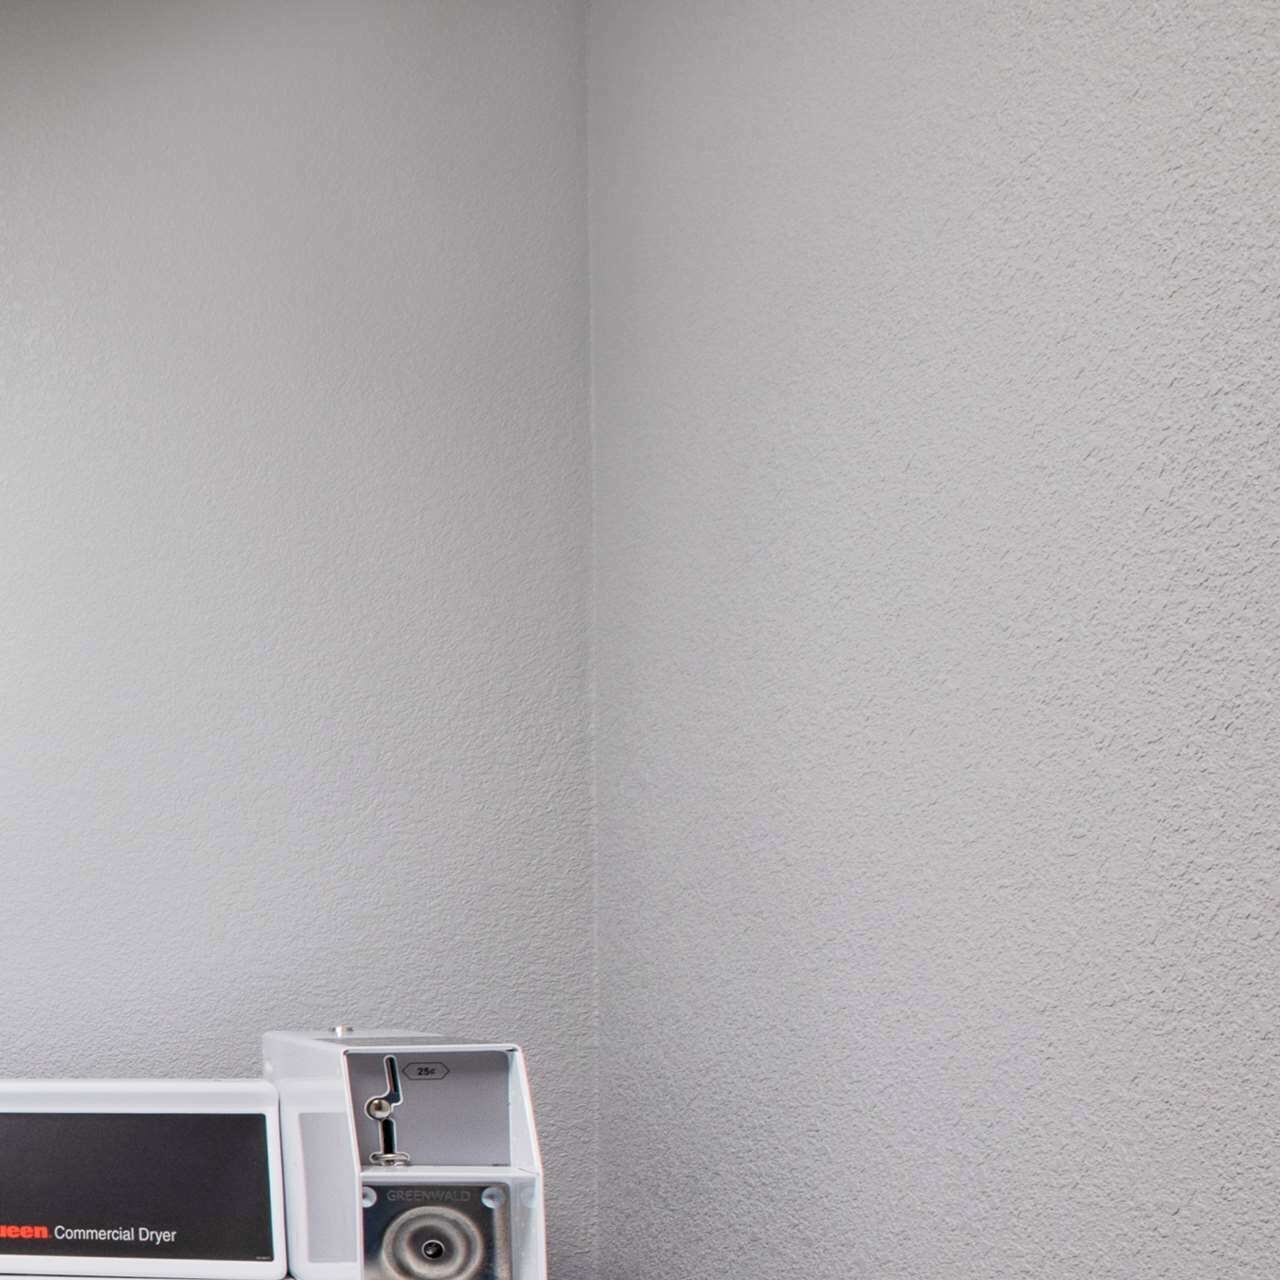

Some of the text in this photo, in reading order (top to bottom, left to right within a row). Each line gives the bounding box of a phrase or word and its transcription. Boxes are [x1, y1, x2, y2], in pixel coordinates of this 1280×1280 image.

[386, 1189, 472, 1202] GREENWALD
[53, 1225, 135, 1242] Commercial
[138, 1227, 177, 1246] Dryer
